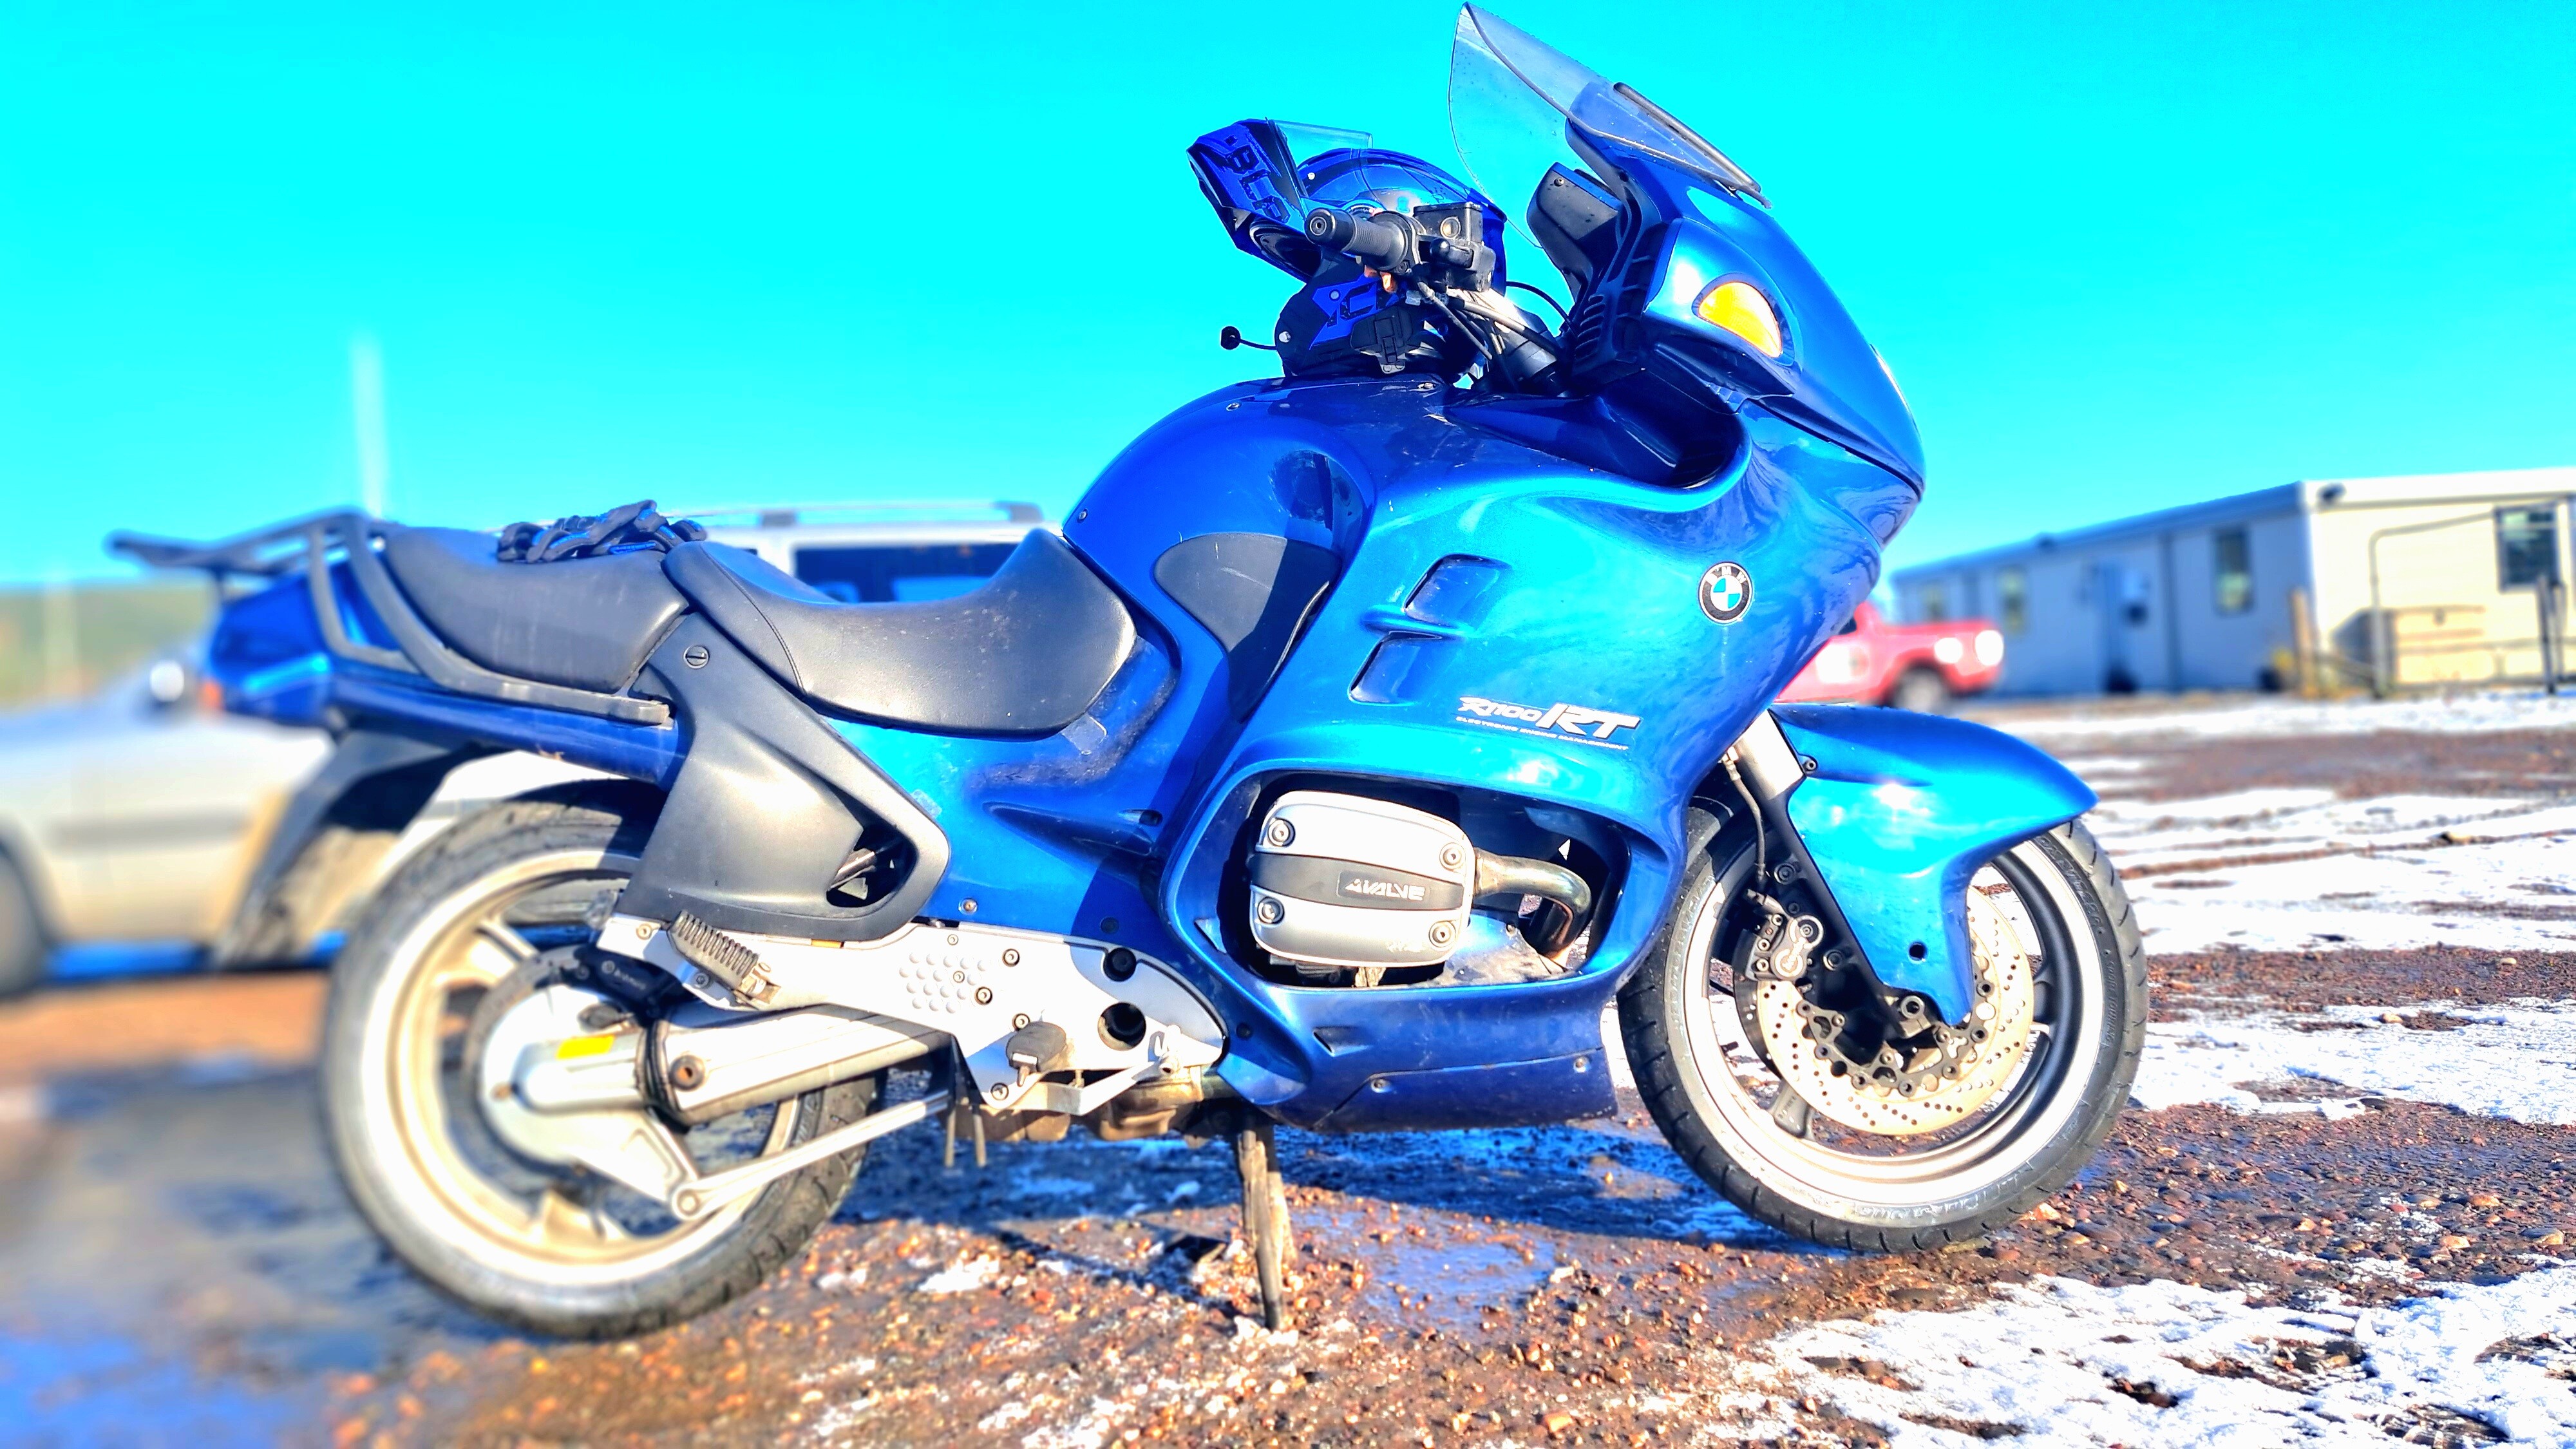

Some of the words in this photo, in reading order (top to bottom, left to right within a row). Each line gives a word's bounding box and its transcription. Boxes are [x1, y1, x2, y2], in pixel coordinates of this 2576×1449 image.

[1455, 715, 1519, 732] ELECTRONIC
[1519, 728, 1558, 739] ENGINE
[1558, 735, 1629, 751] MANAGEMENT
